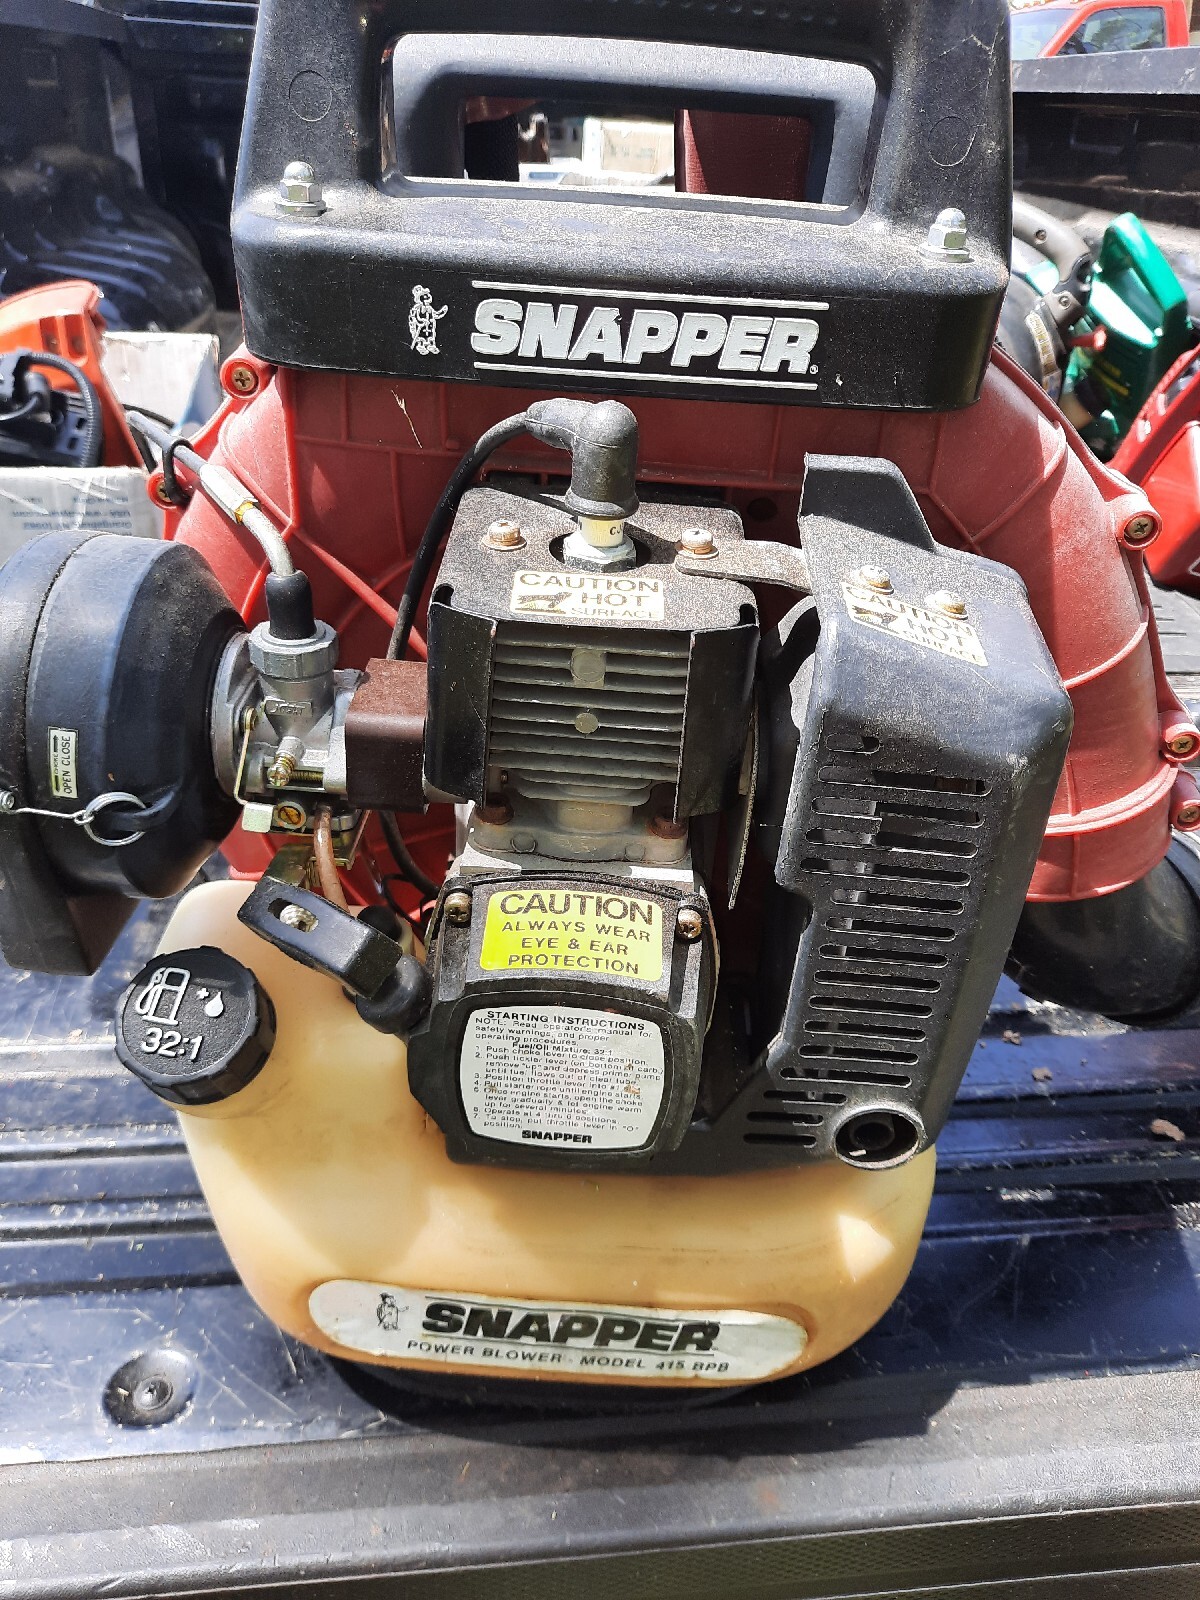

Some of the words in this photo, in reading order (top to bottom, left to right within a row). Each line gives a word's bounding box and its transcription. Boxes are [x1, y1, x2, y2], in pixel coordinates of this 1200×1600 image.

[470, 298, 819, 374] SNAPPER
[519, 573, 659, 592] CAUTION
[581, 592, 650, 607] HOT
[571, 607, 659, 619] SURFACE
[845, 586, 972, 636] CAUTION
[906, 618, 966, 647] HOT
[62, 736, 71, 766] CLOSE
[62, 770, 73, 794] OPEN
[500, 893, 652, 926] CAUTION
[502, 921, 586, 932] ALWAYS
[596, 923, 651, 942] WEAR
[521, 937, 560, 949] EYE
[568, 938, 580, 950] &
[590, 940, 629, 956] EAR
[508, 954, 639, 975] PROTECTION
[487, 1010, 548, 1022] STARTING
[554, 1016, 645, 1030] INSTRUCTIONS
[512, 1020, 537, 1028] Read
[598, 1028, 632, 1036] manual
[640, 1030, 652, 1038] for
[476, 1026, 504, 1034] safety
[578, 1034, 610, 1042] proper
[476, 1034, 520, 1042] operating
[140, 1026, 203, 1062] 32:1
[486, 1046, 510, 1054] Push
[512, 1048, 540, 1056] choke
[512, 1041, 548, 1050] Fuel/Oil
[594, 1048, 612, 1056] 32:1
[486, 1052, 510, 1060] Push
[484, 1080, 502, 1088] Pull
[485, 1074, 524, 1082] Position
[600, 1096, 614, 1104] the
[618, 1106, 642, 1114] warm
[522, 1130, 592, 1144] SNAPPER
[422, 1300, 720, 1351] SNAPPER
[408, 1340, 475, 1356] POWER
[482, 1346, 564, 1363] BLOWER
[580, 1356, 647, 1370] MODEL
[656, 1360, 686, 1370] 415
